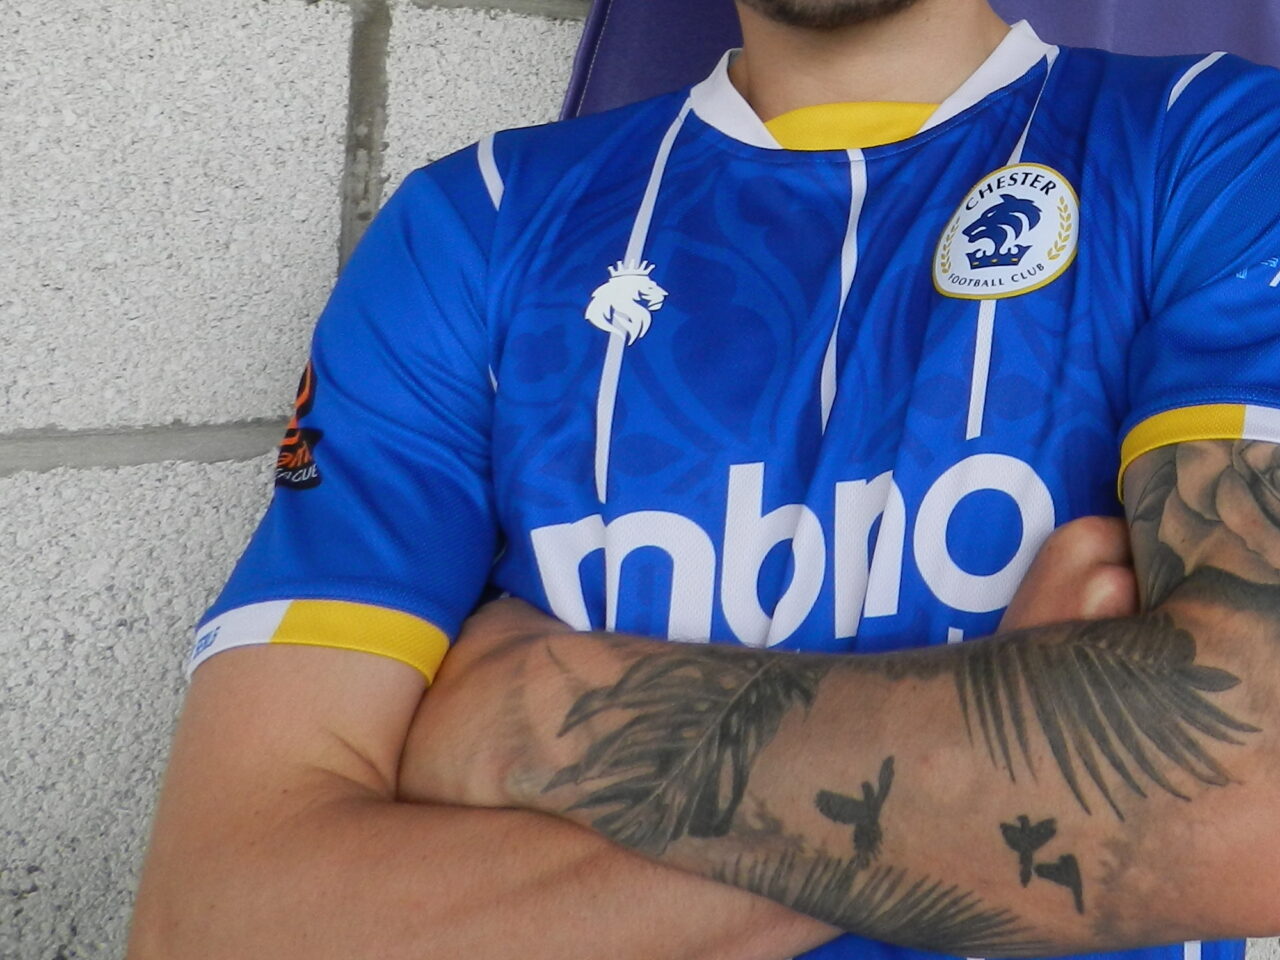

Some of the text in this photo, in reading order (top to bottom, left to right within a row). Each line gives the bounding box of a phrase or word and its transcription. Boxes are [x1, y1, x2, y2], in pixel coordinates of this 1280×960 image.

[965, 171, 1057, 212] CHESTER
[948, 262, 1045, 288] FOOTBALL CLUB
